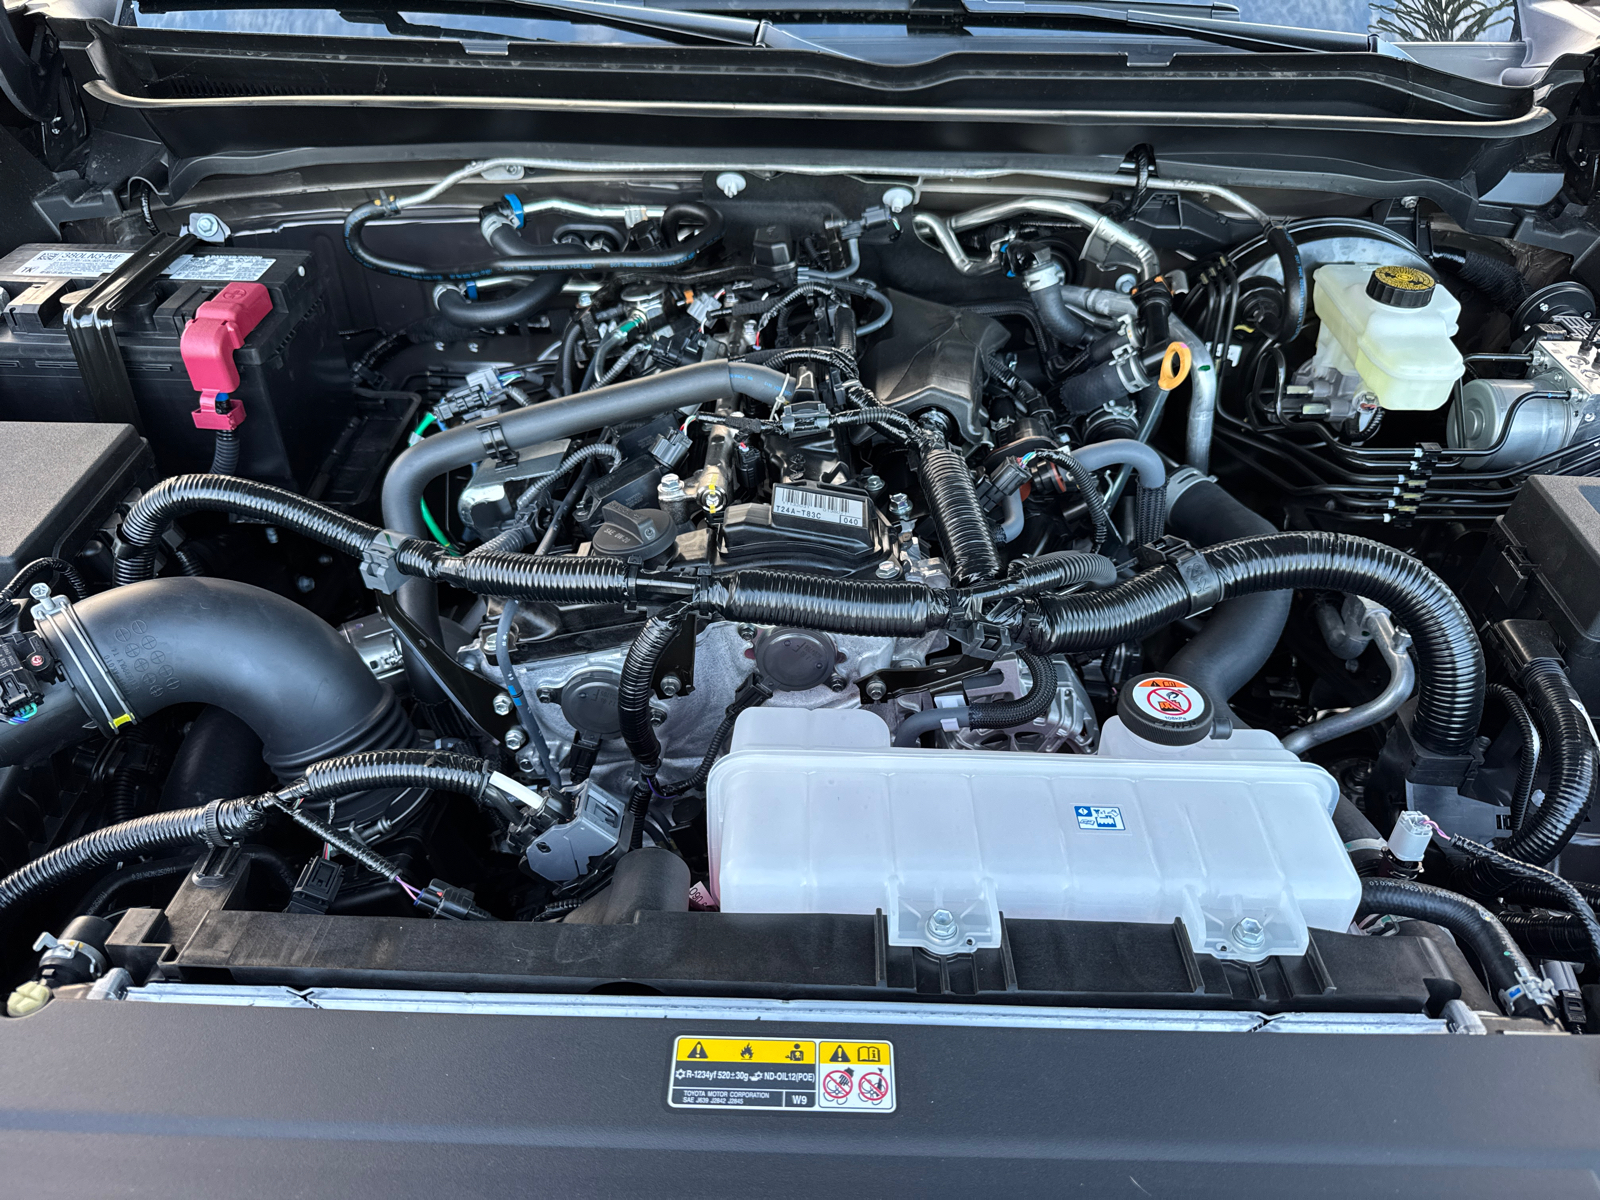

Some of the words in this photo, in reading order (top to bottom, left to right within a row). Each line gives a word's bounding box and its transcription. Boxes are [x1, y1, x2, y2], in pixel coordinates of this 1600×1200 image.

[843, 517, 859, 526] 040
[603, 528, 617, 536] SAE
[686, 1070, 717, 1081] R-1234yf
[717, 1071, 749, 1082] 520±30g
[764, 1072, 816, 1083] ND-OIL12(POE)
[729, 1091, 770, 1099] CORPORATION
[791, 1095, 808, 1105] W9
